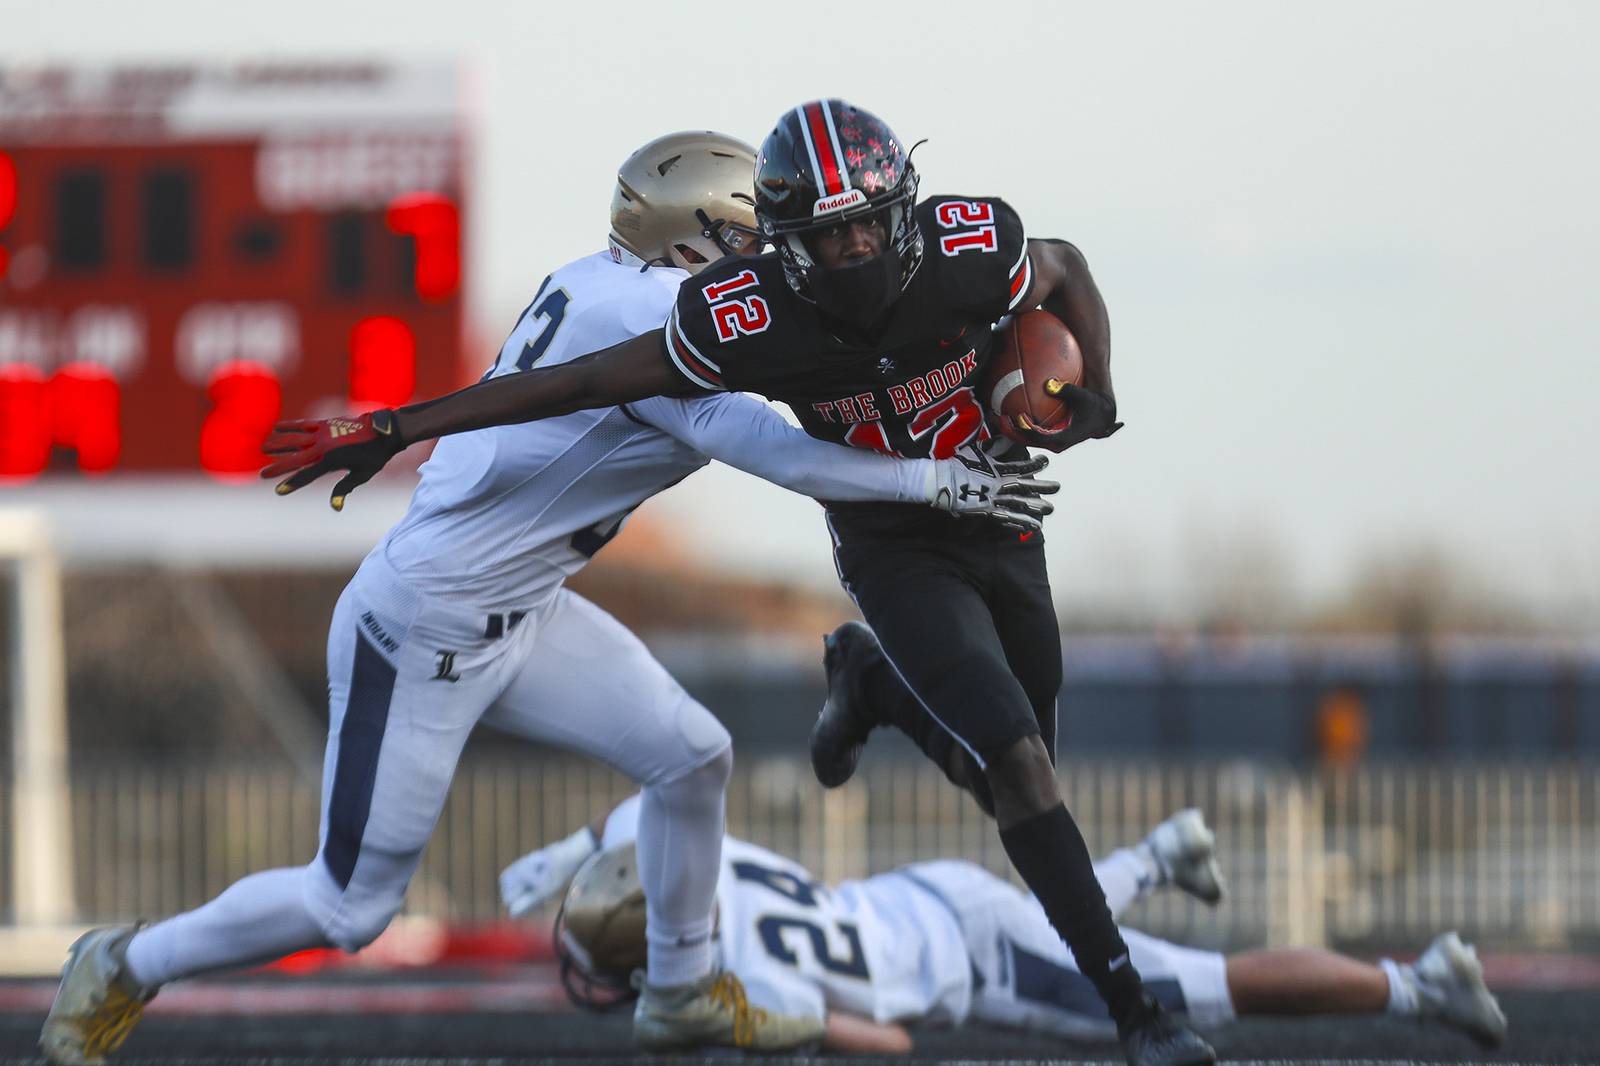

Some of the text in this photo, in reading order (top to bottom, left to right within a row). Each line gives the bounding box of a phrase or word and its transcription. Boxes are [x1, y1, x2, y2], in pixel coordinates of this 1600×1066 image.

[818, 192, 859, 211] Riddell
[935, 199, 998, 257] 12
[701, 268, 772, 343] 12
[812, 348, 978, 425] THE BROOK
[730, 861, 872, 982] 24
